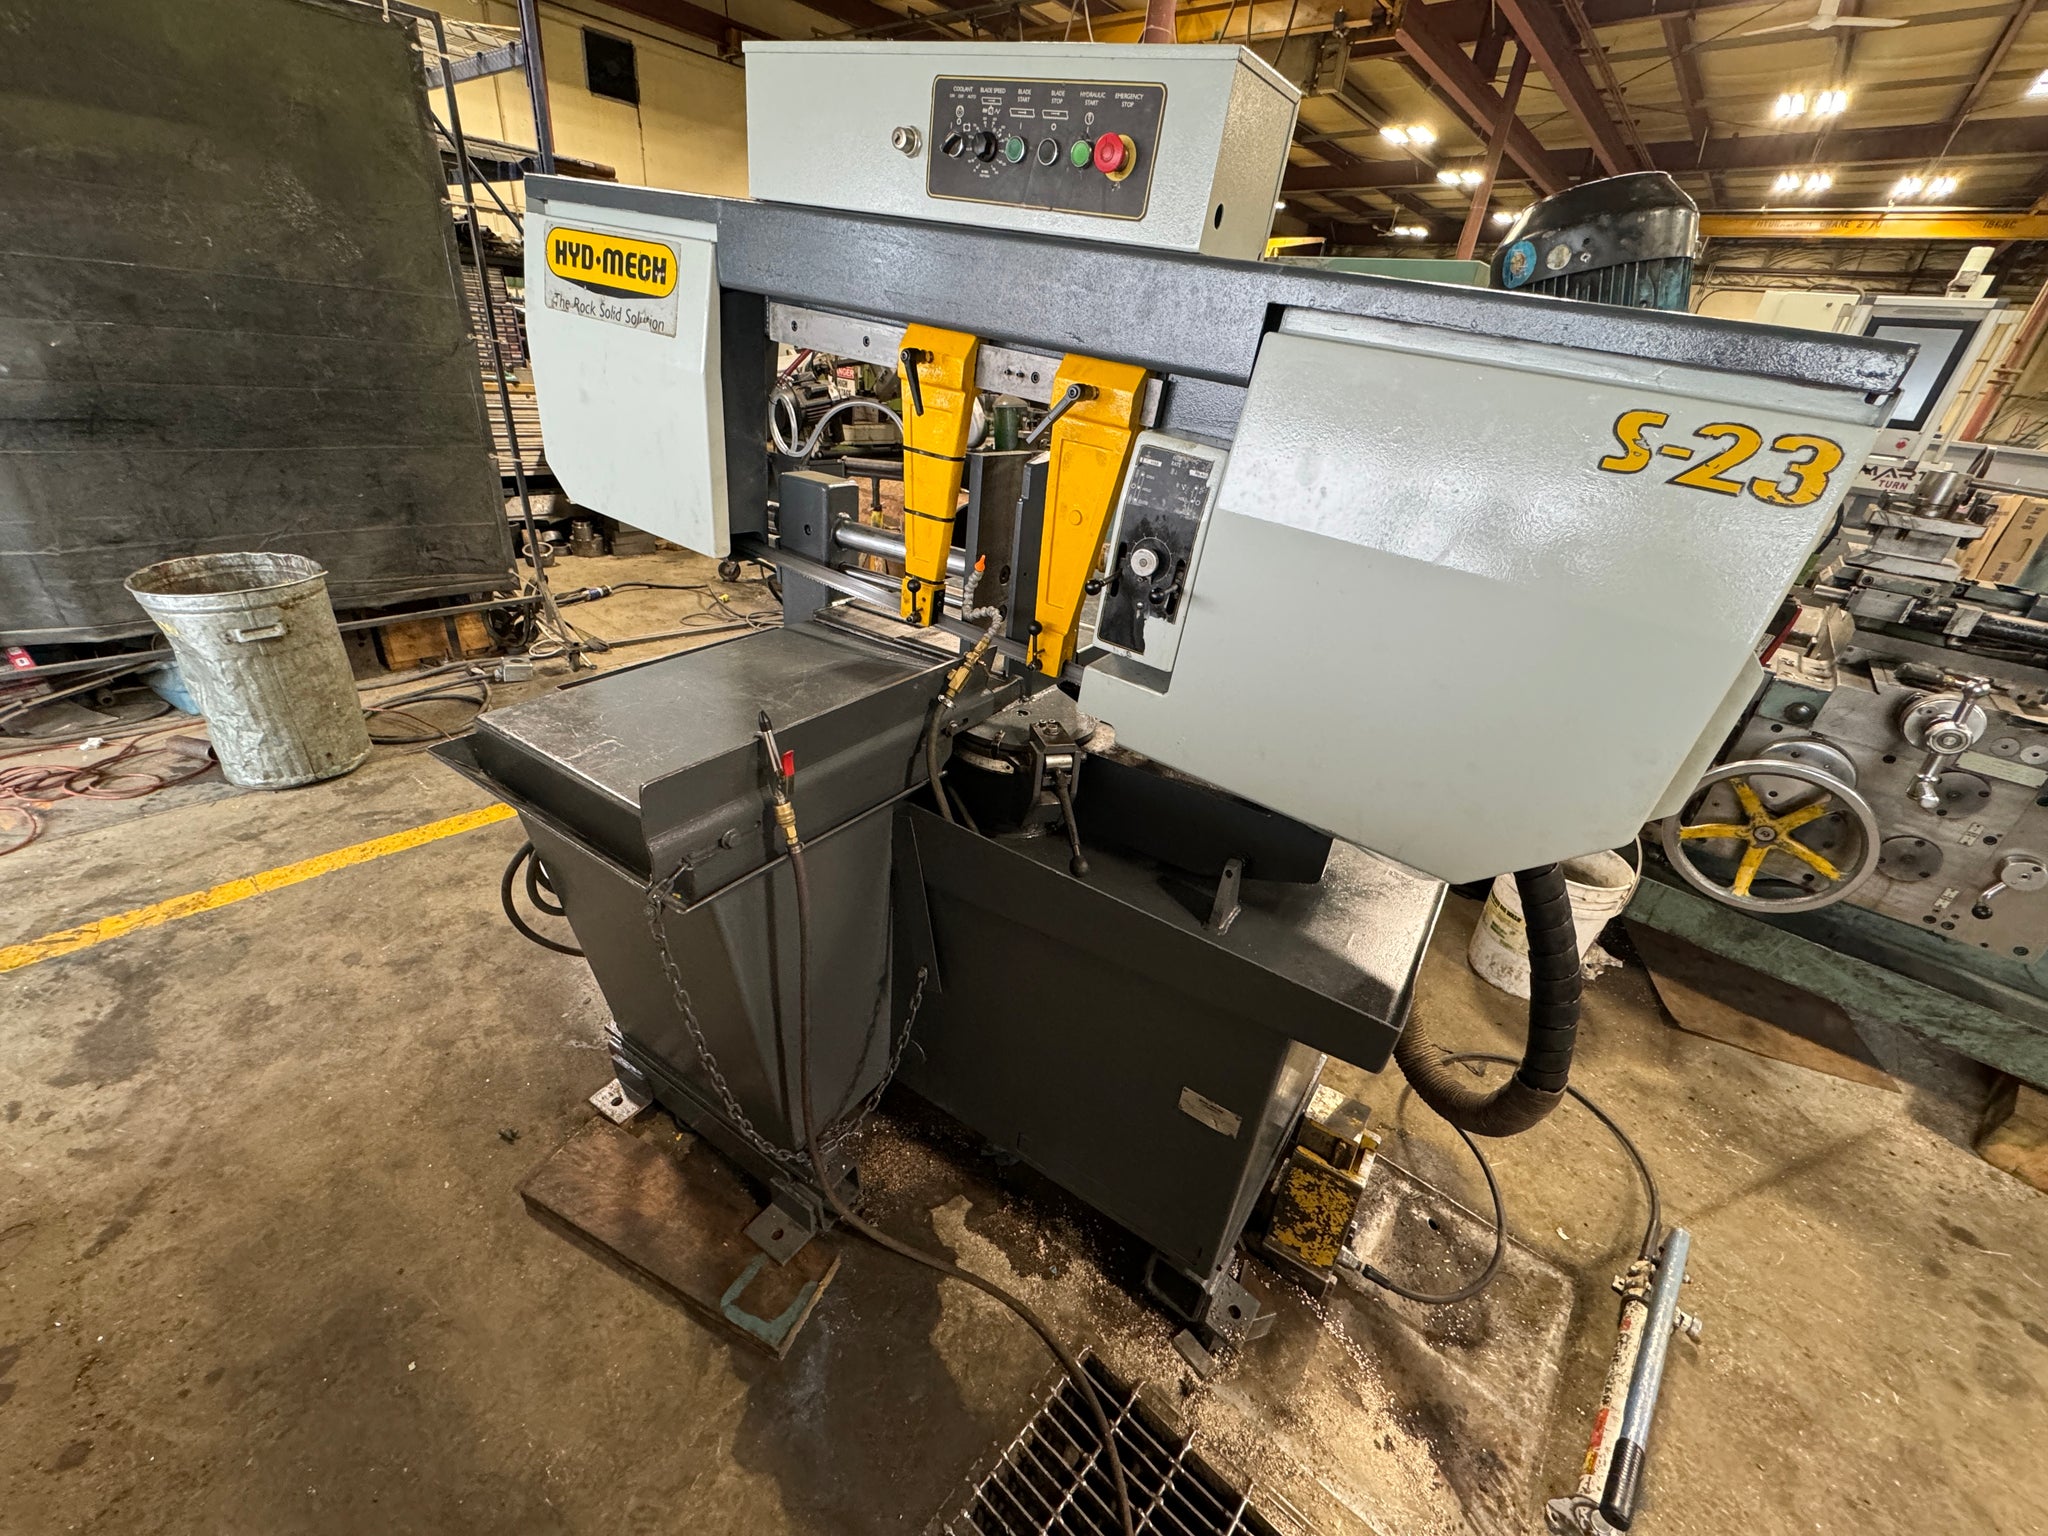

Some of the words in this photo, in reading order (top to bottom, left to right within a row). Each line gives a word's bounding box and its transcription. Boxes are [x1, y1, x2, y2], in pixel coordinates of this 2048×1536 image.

[1079, 91, 1106, 99] HYDRAULIC
[1114, 92, 1144, 100] EMERGENCY
[554, 292, 571, 310] The
[573, 297, 596, 316] Rock
[599, 302, 622, 322] Solid
[1597, 408, 1845, 507] S-23
[1878, 479, 1909, 491] TURN
